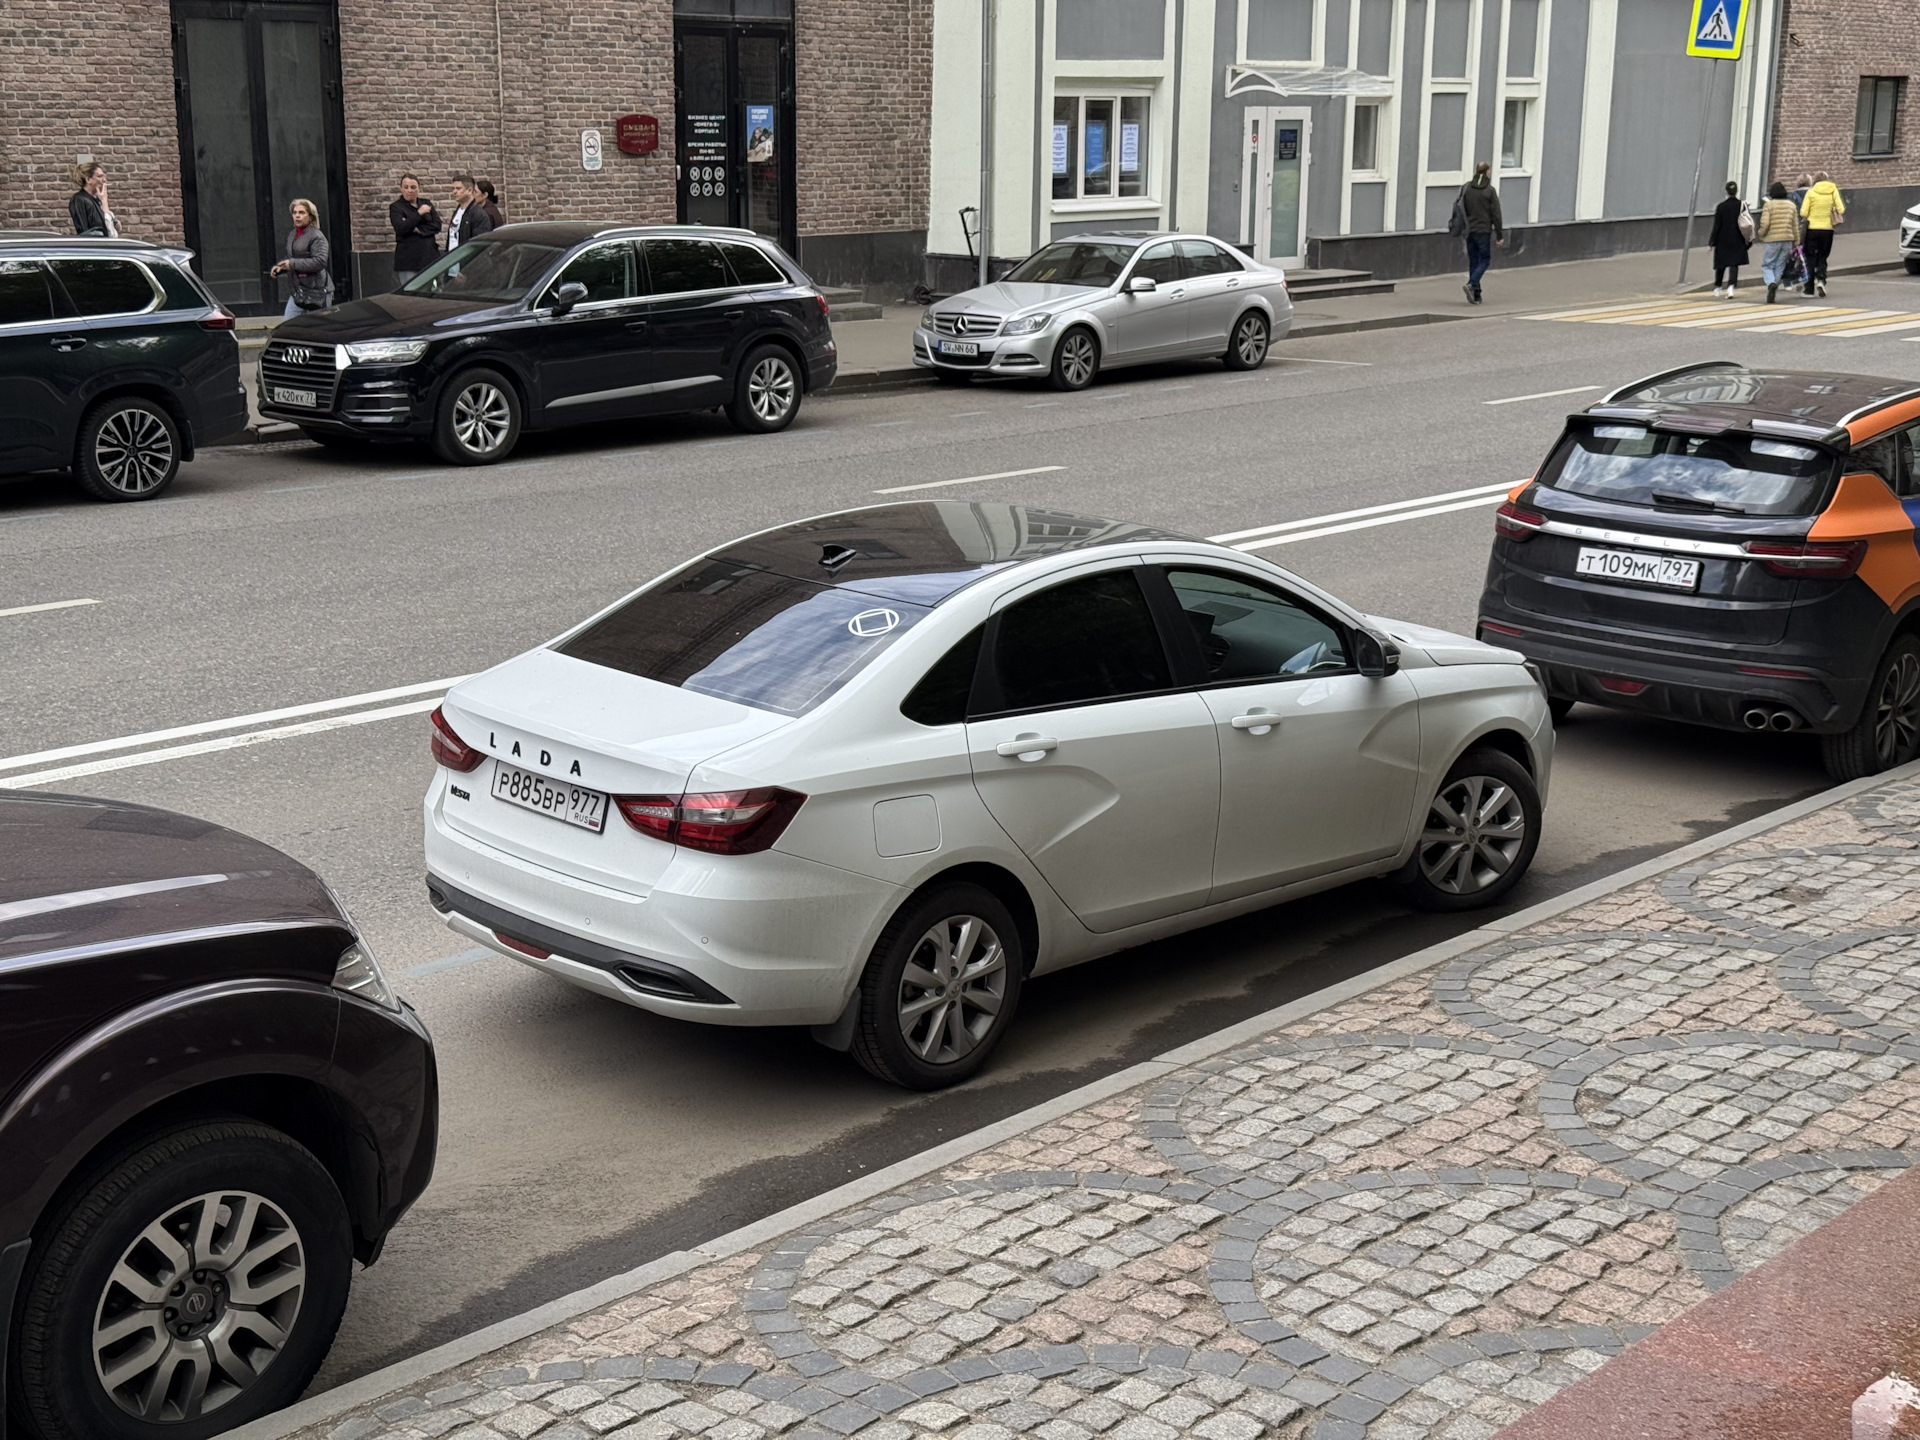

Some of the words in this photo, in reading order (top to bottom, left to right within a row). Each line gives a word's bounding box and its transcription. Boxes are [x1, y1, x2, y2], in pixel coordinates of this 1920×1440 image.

[965, 345, 974, 353] 66
[1575, 527, 1700, 549] GEELY
[1586, 553, 1658, 579] Т109МК
[1663, 560, 1692, 578] 797
[1666, 575, 1681, 583] RUS
[490, 732, 581, 777] LADA
[499, 771, 565, 812] Р885ВР
[571, 789, 600, 816] 977
[574, 812, 589, 824] RUS
